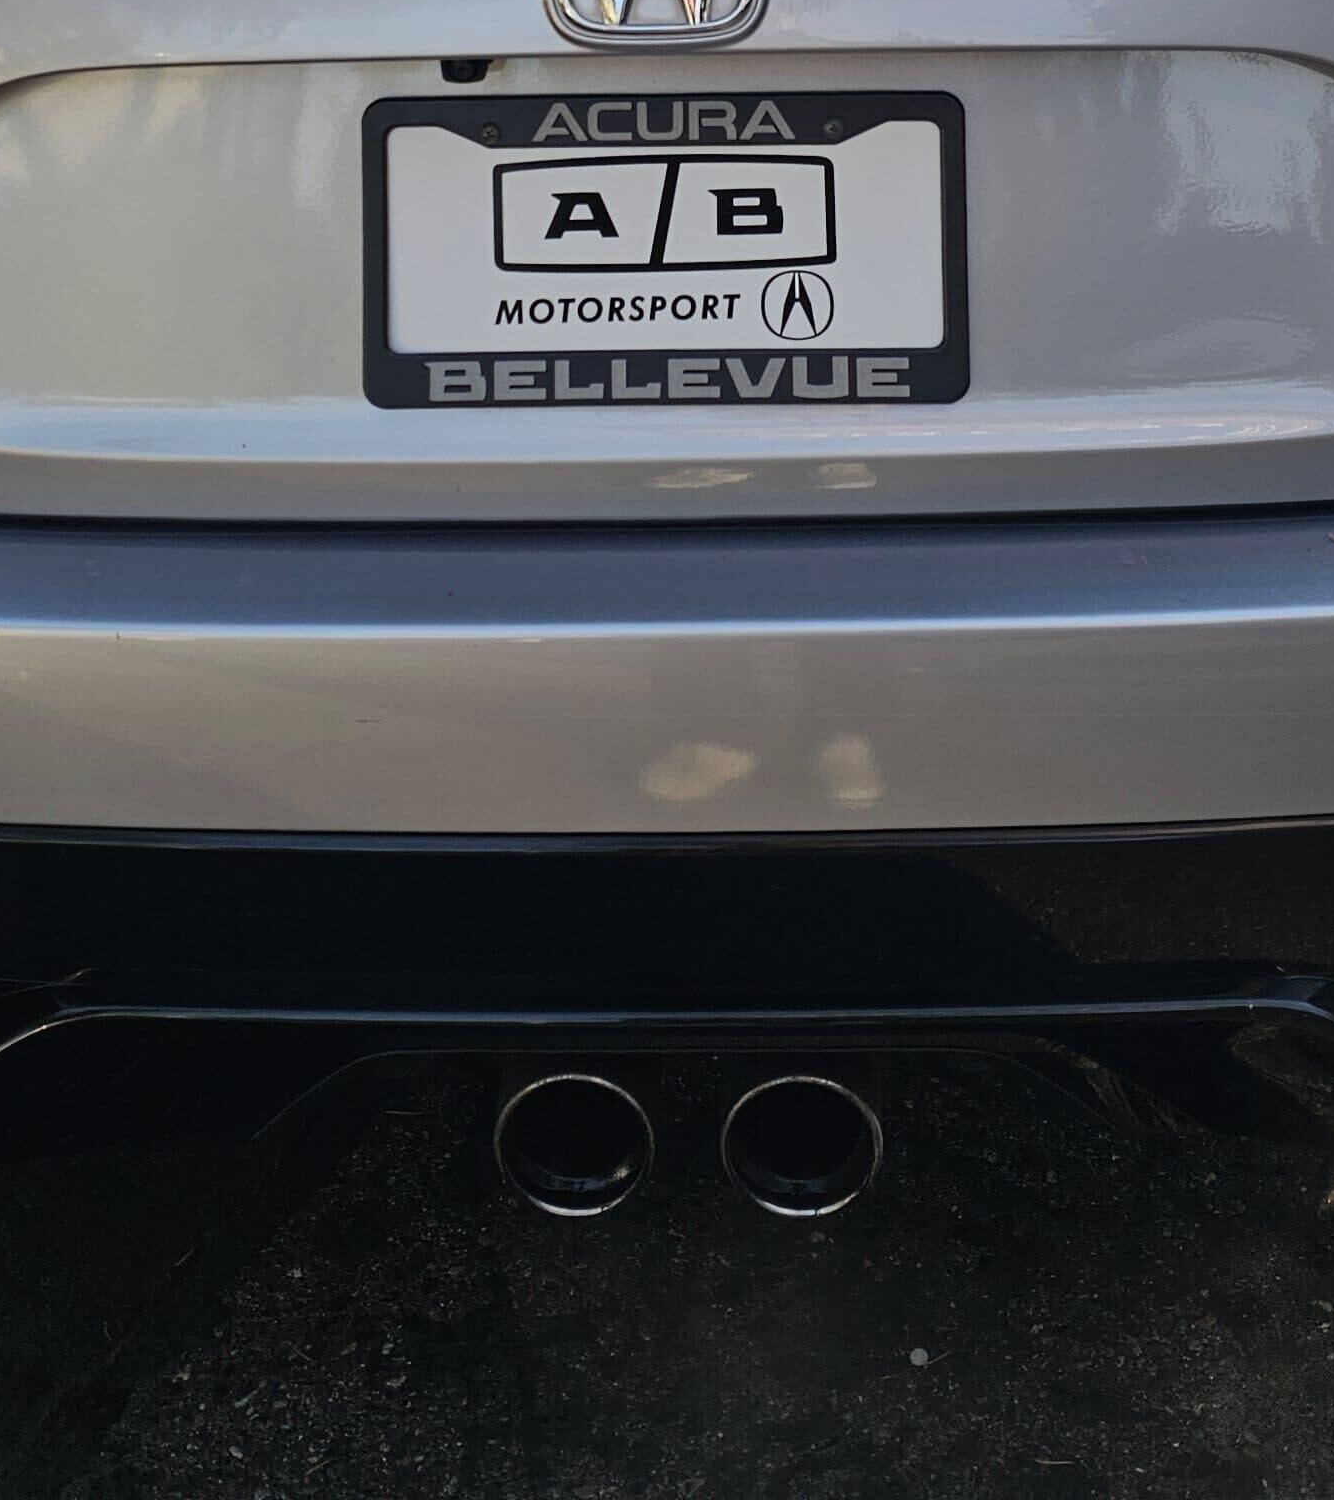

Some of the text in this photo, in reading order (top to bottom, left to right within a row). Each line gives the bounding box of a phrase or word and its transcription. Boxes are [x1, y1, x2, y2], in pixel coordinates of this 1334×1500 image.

[531, 99, 796, 142] ACURA
[494, 293, 742, 325] MOTORSPORT
[423, 355, 912, 403] BELLEVUE
